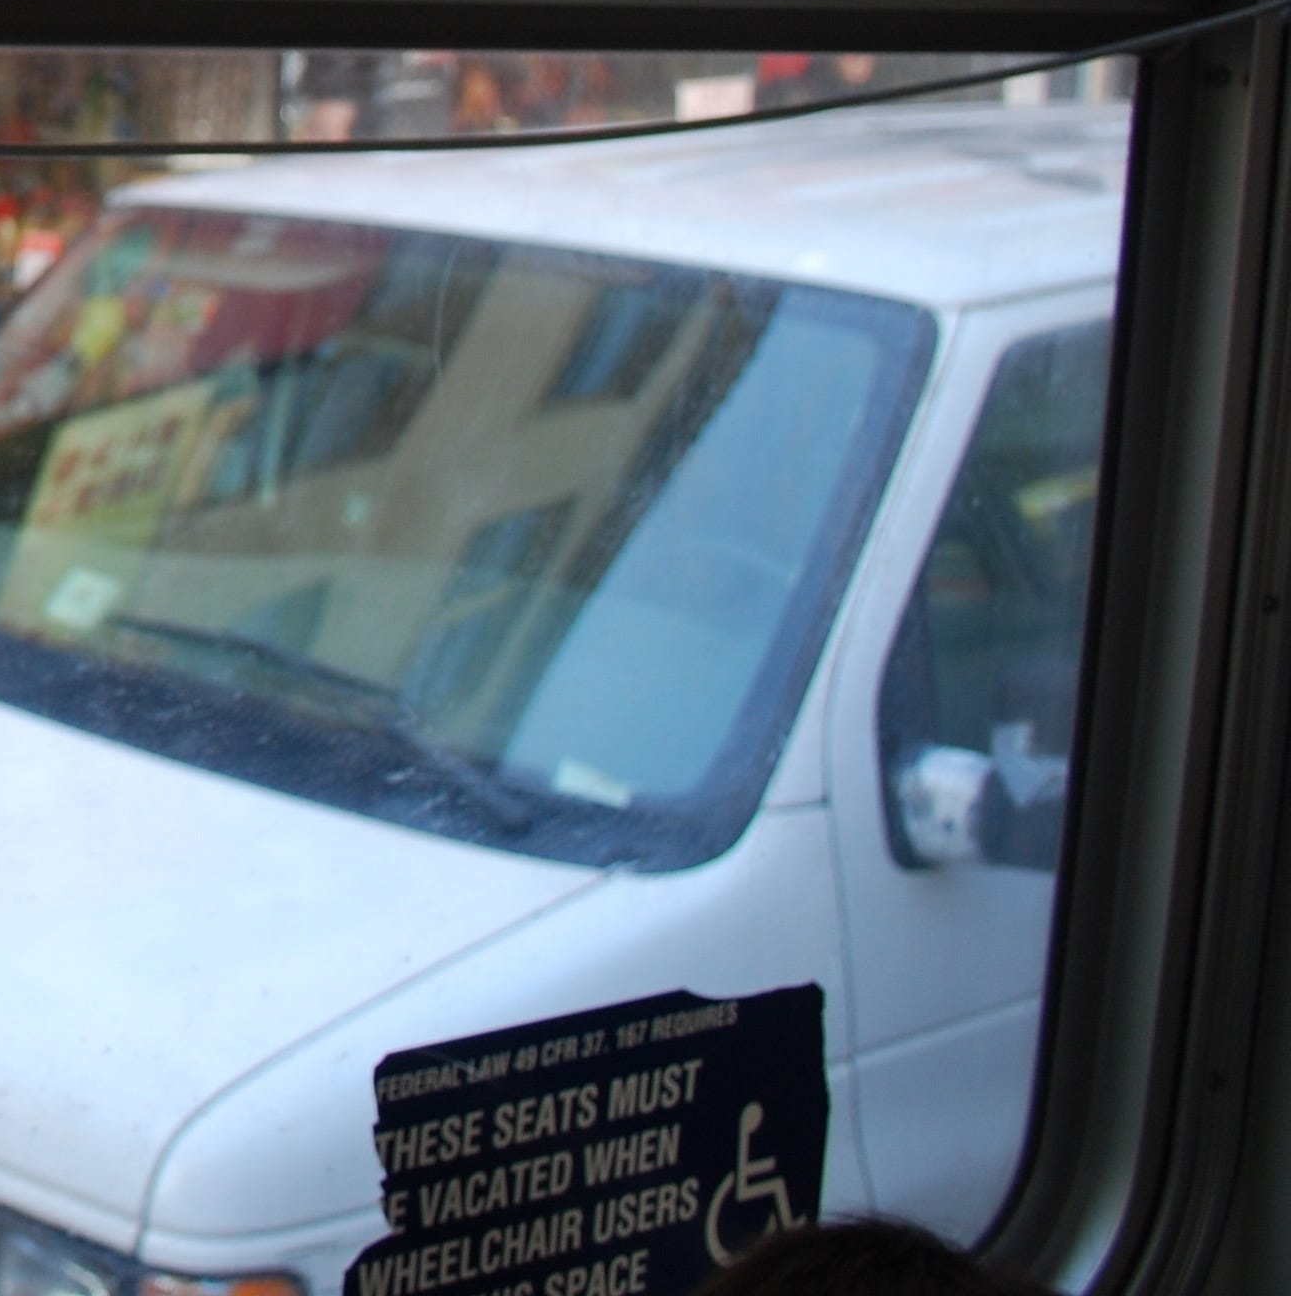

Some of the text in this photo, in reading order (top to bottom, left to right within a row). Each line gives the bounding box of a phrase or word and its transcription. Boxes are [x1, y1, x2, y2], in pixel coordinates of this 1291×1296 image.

[375, 1065, 462, 1105] FEDERAL
[467, 1050, 511, 1086] LAW
[515, 1046, 538, 1073] 49
[540, 1033, 579, 1068] CFR
[619, 1020, 647, 1052] 167
[651, 1000, 739, 1044] REQUIRES
[375, 1060, 703, 1174] THESE SEATS MUST
[419, 1152, 573, 1221] VACATED
[583, 1123, 682, 1186] WHEN
[357, 1177, 699, 1296] WHEELCHAIR USERS
[544, 1249, 650, 1296] SPACE
